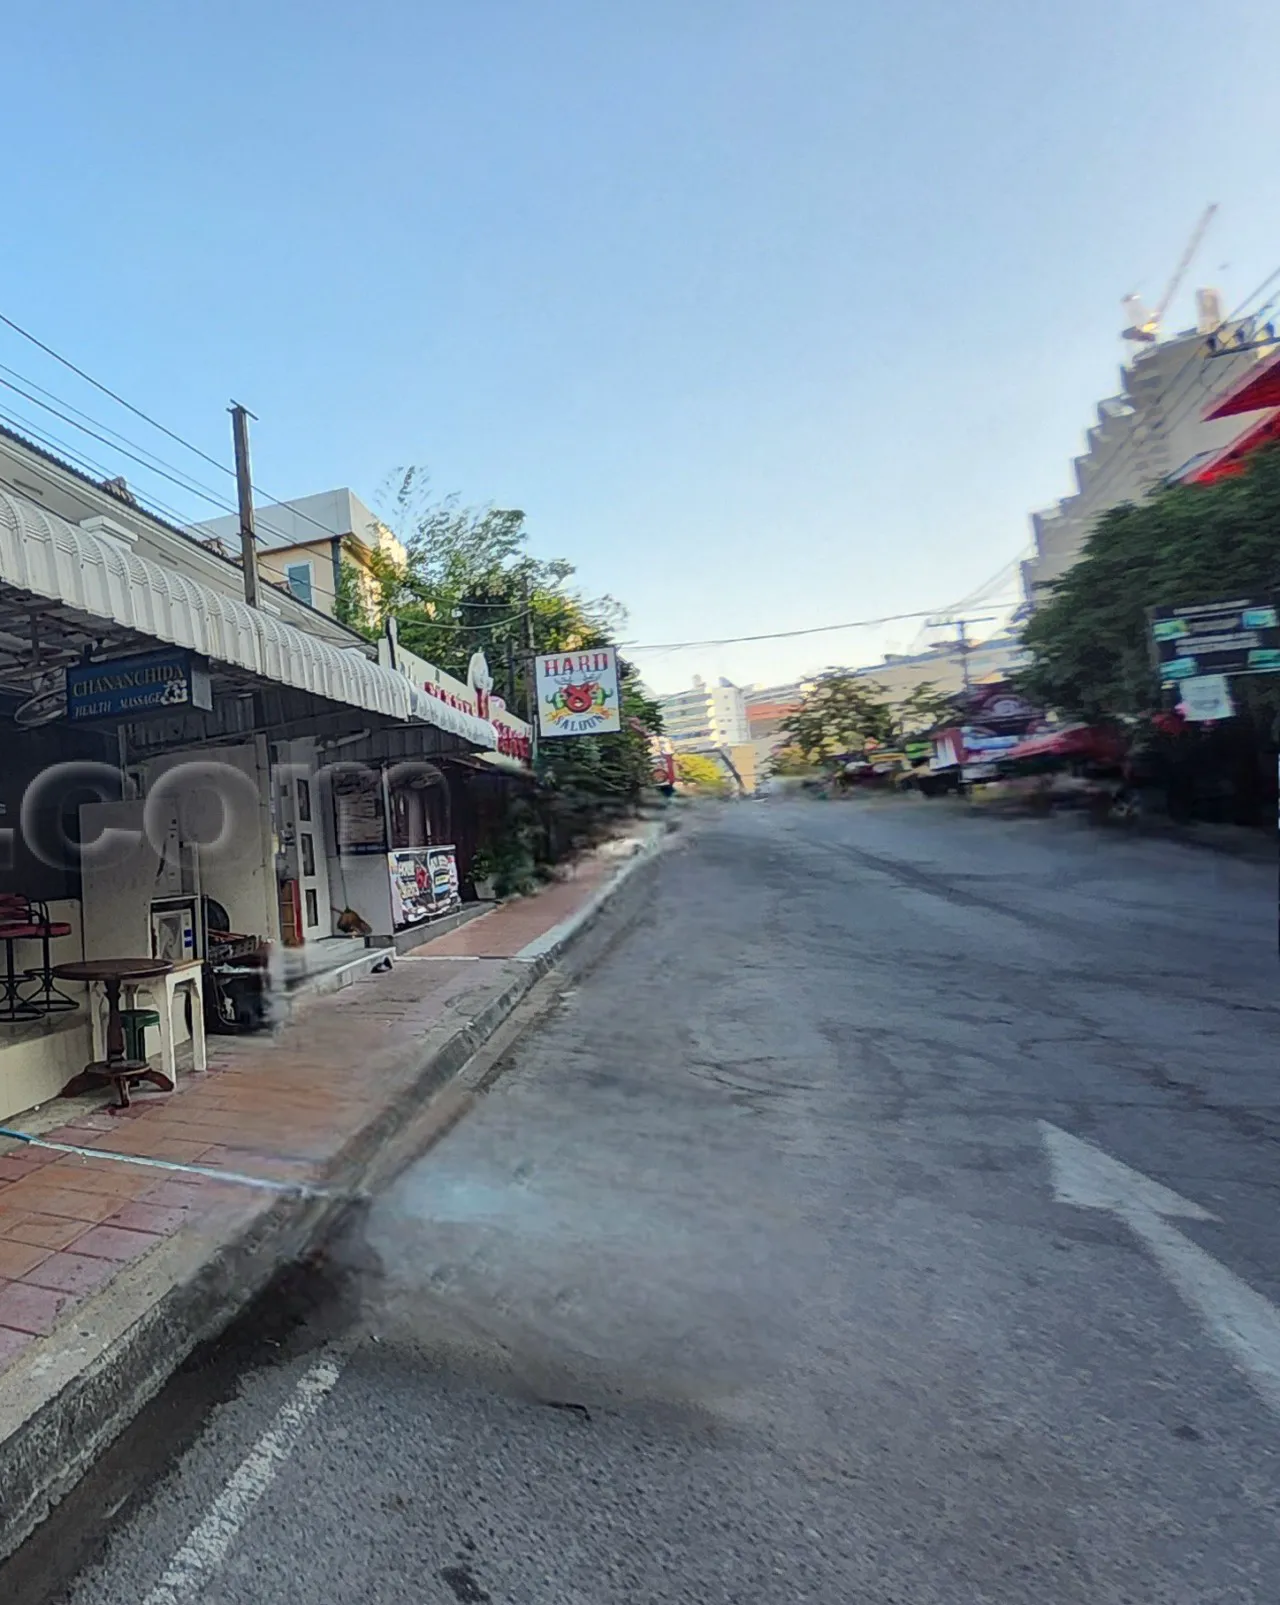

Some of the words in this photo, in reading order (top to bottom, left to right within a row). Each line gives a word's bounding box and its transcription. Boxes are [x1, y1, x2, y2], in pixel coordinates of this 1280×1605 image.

[543, 652, 609, 677] HARD
[72, 664, 184, 697] CHANANCHIDA
[74, 701, 112, 718] HEALTH
[120, 691, 163, 708] MASSAGE
